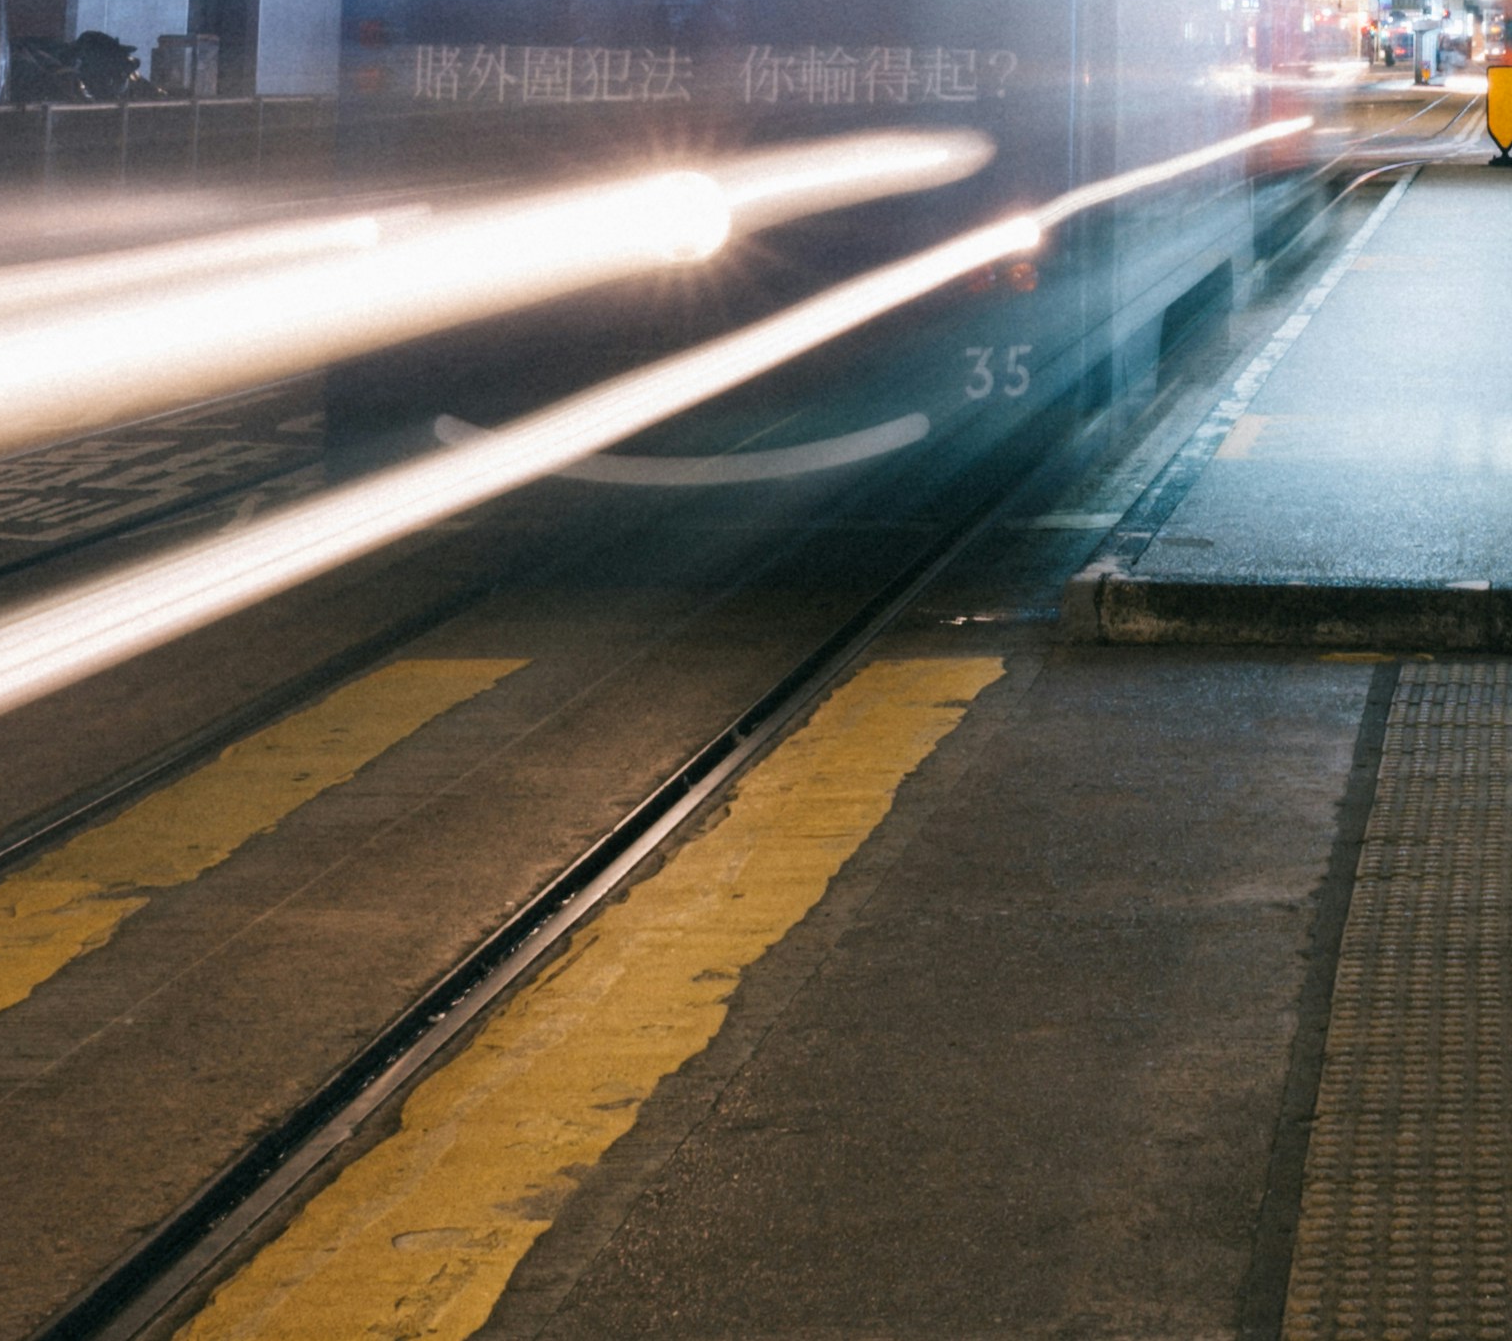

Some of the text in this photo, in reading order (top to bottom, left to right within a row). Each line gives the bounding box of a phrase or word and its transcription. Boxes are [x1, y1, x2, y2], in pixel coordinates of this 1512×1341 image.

[414, 44, 1020, 105] 賭外圍犯法 你輸得起?
[965, 343, 1034, 399] 35
